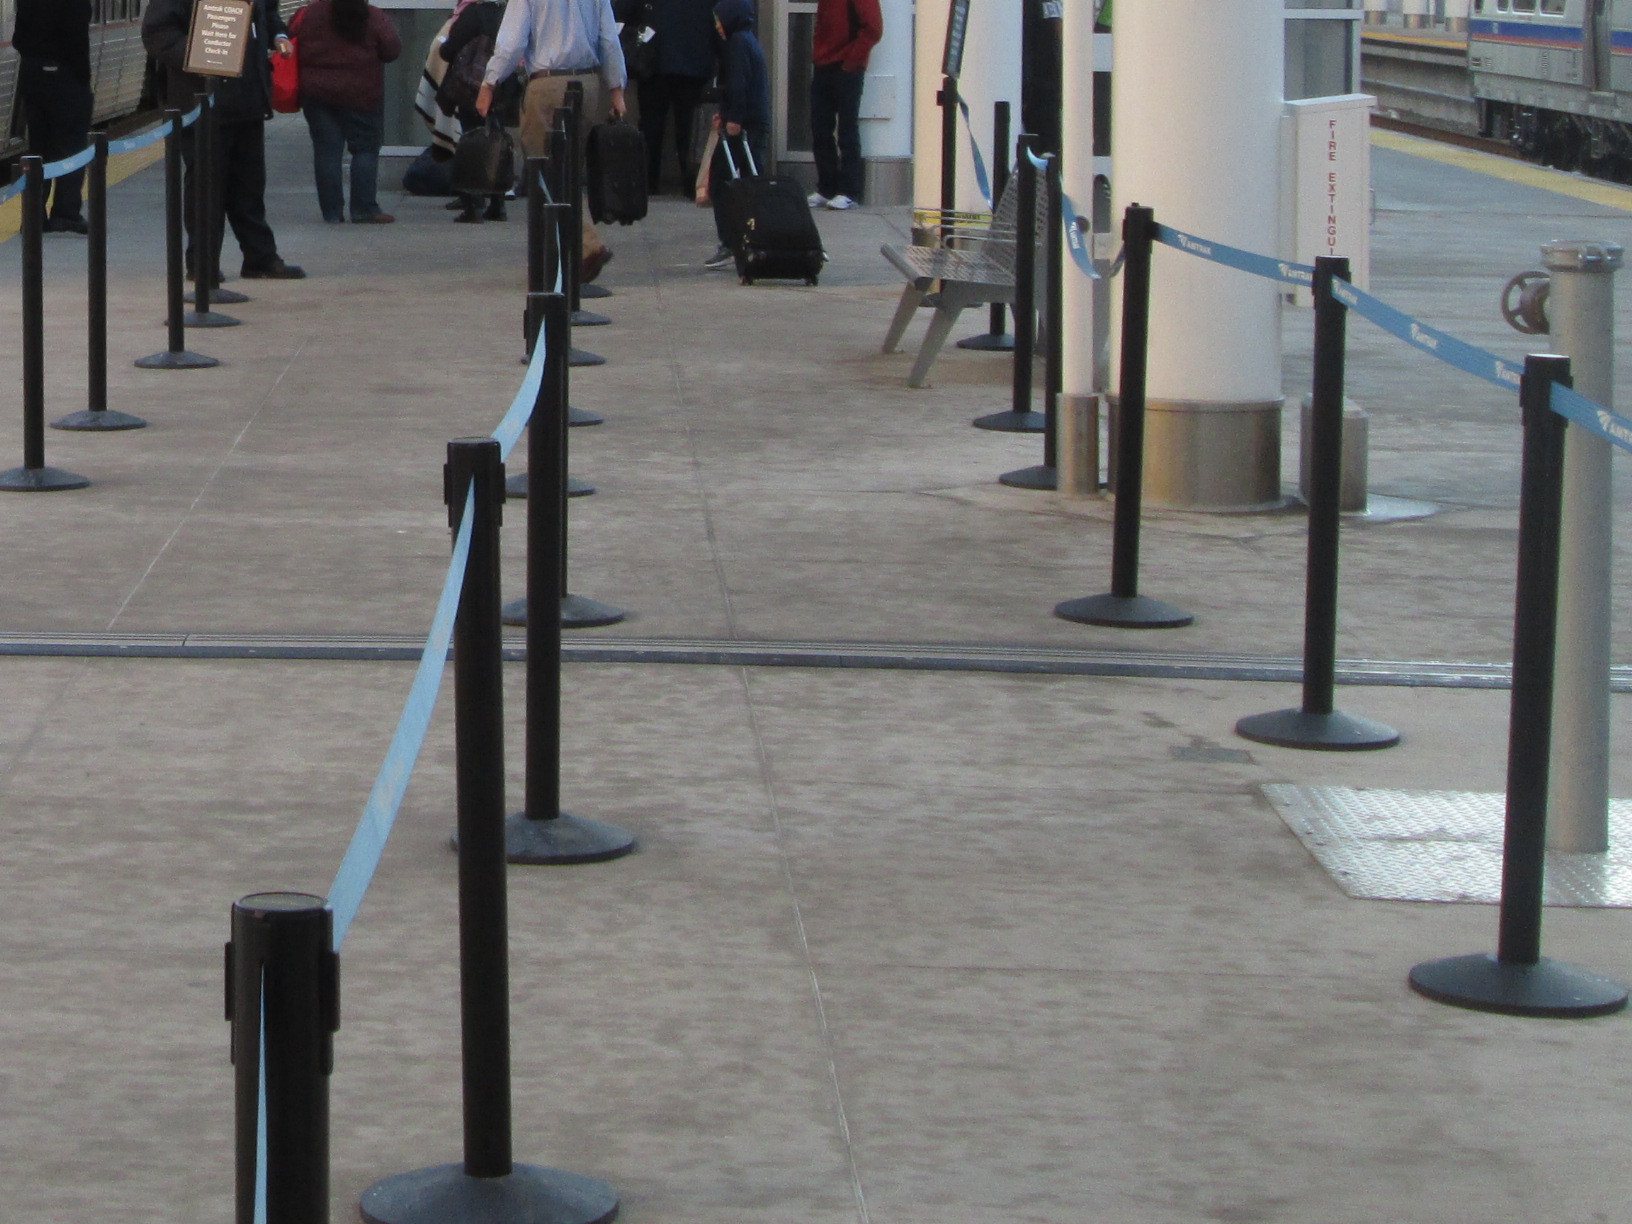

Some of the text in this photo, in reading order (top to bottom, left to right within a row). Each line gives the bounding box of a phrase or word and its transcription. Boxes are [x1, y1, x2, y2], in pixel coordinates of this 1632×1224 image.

[203, 4, 244, 15] Amtrak COACH
[206, 13, 236, 23] Passengers
[1328, 119, 1337, 161] FIRE
